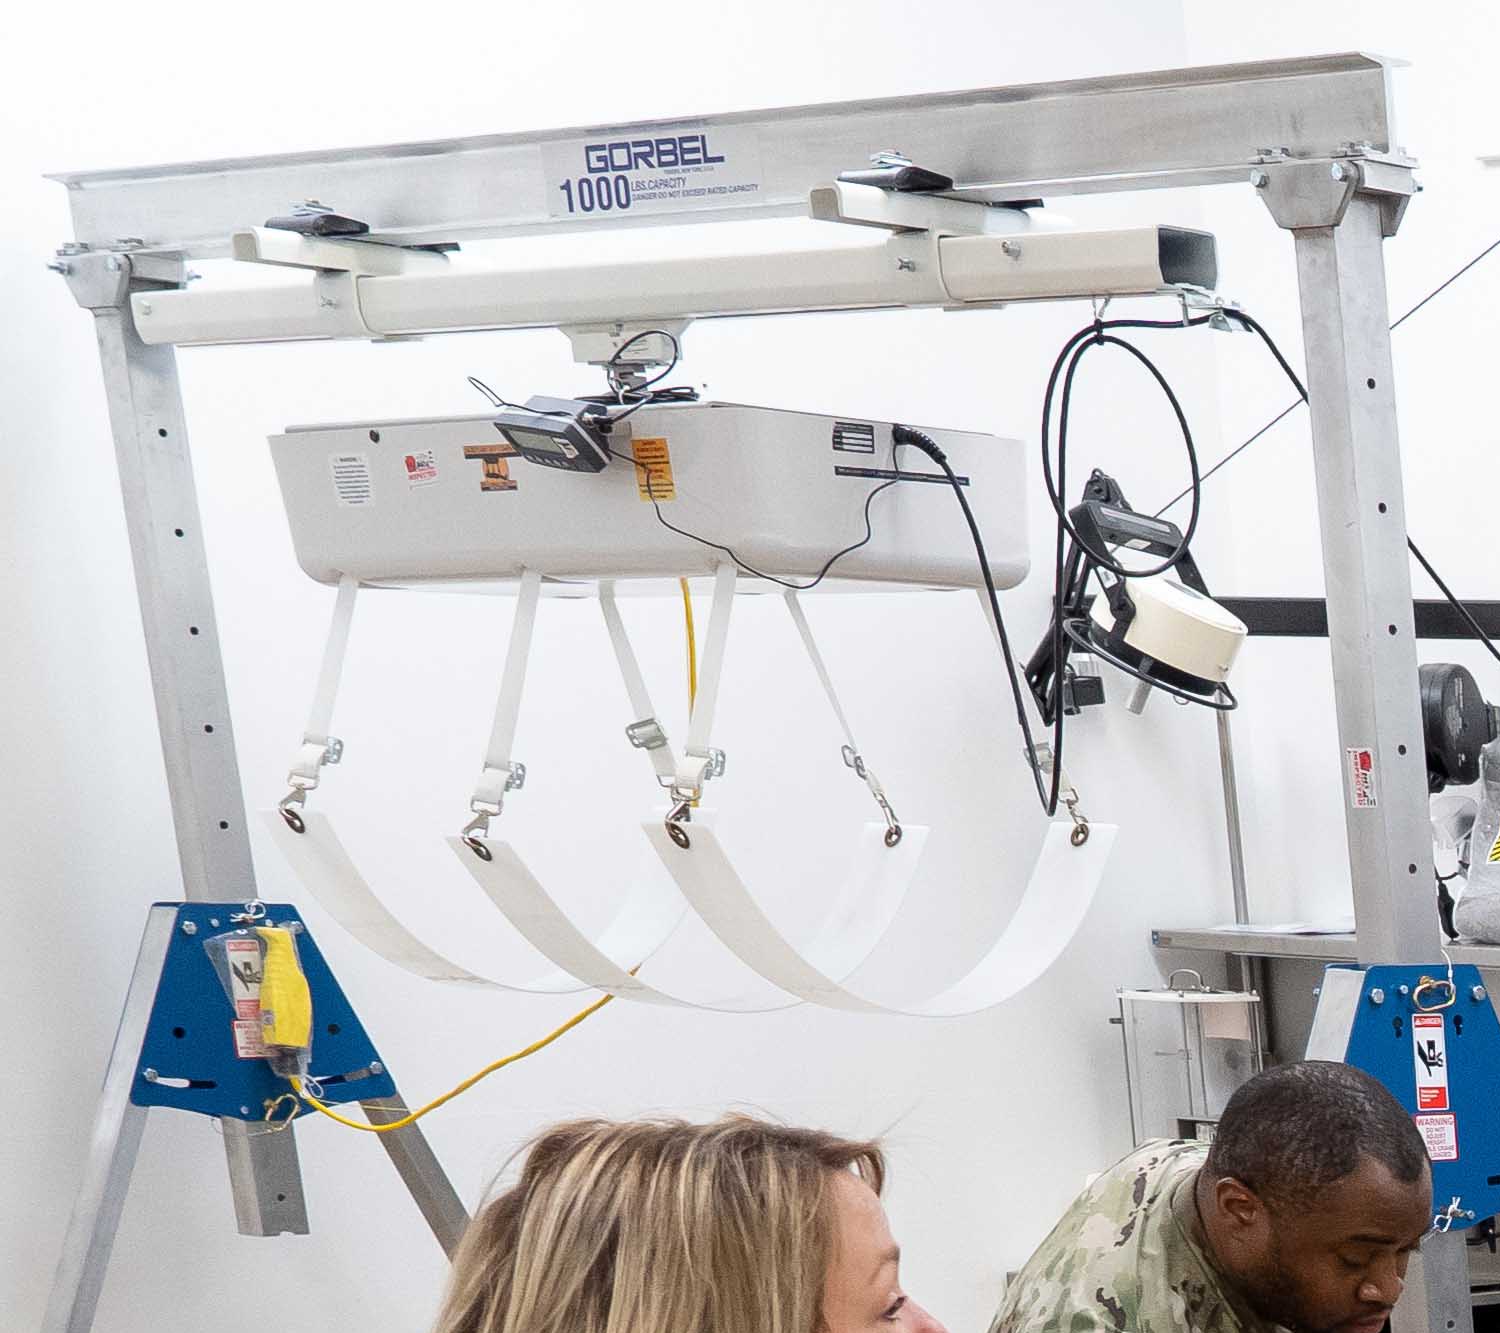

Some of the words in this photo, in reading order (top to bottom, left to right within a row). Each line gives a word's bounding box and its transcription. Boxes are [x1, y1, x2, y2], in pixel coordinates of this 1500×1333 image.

[585, 134, 725, 174] GORBEL
[560, 174, 632, 213] 1000
[649, 176, 686, 190] CAPACITY
[1417, 1116, 1454, 1126] WARNING
